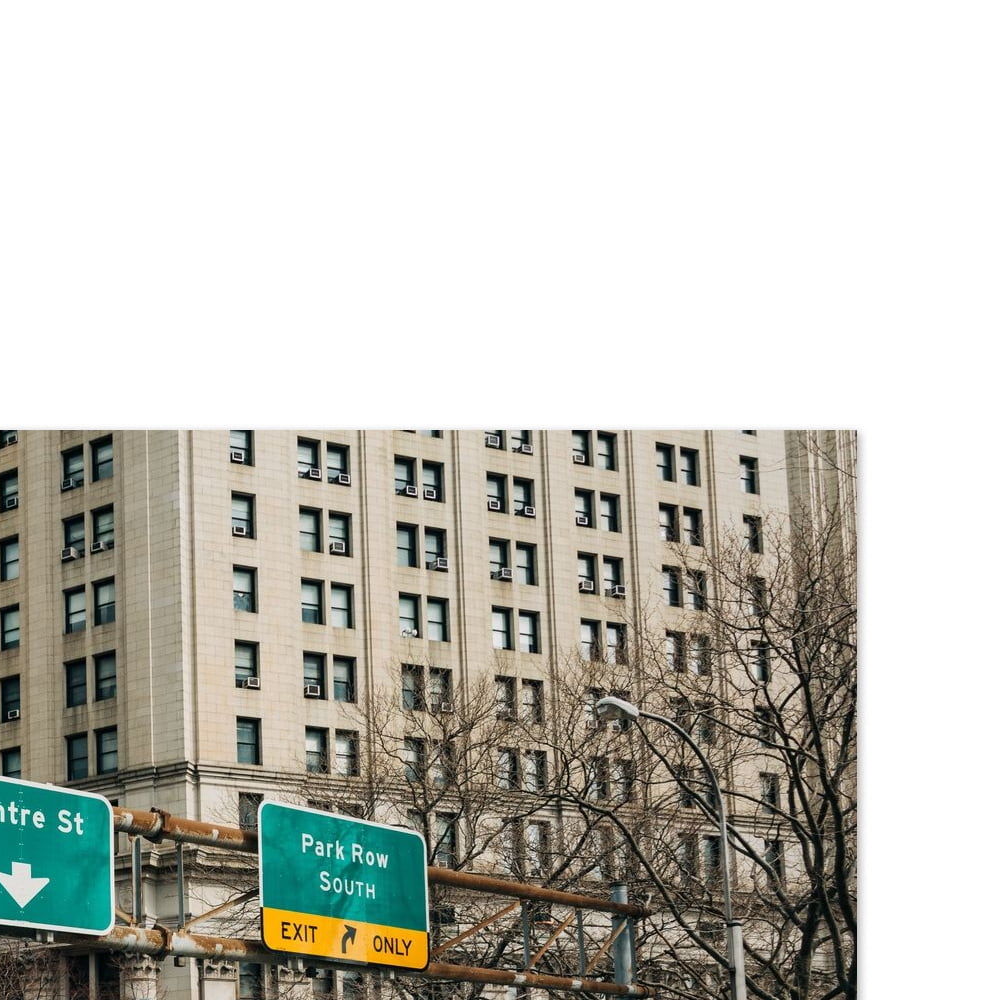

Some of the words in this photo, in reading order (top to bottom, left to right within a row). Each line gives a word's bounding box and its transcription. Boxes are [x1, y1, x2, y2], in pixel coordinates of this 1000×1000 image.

[57, 808, 84, 836] St
[301, 832, 345, 861] Park
[351, 842, 389, 869] Row
[281, 921, 318, 944] EXIT
[373, 935, 412, 957] ONLY
